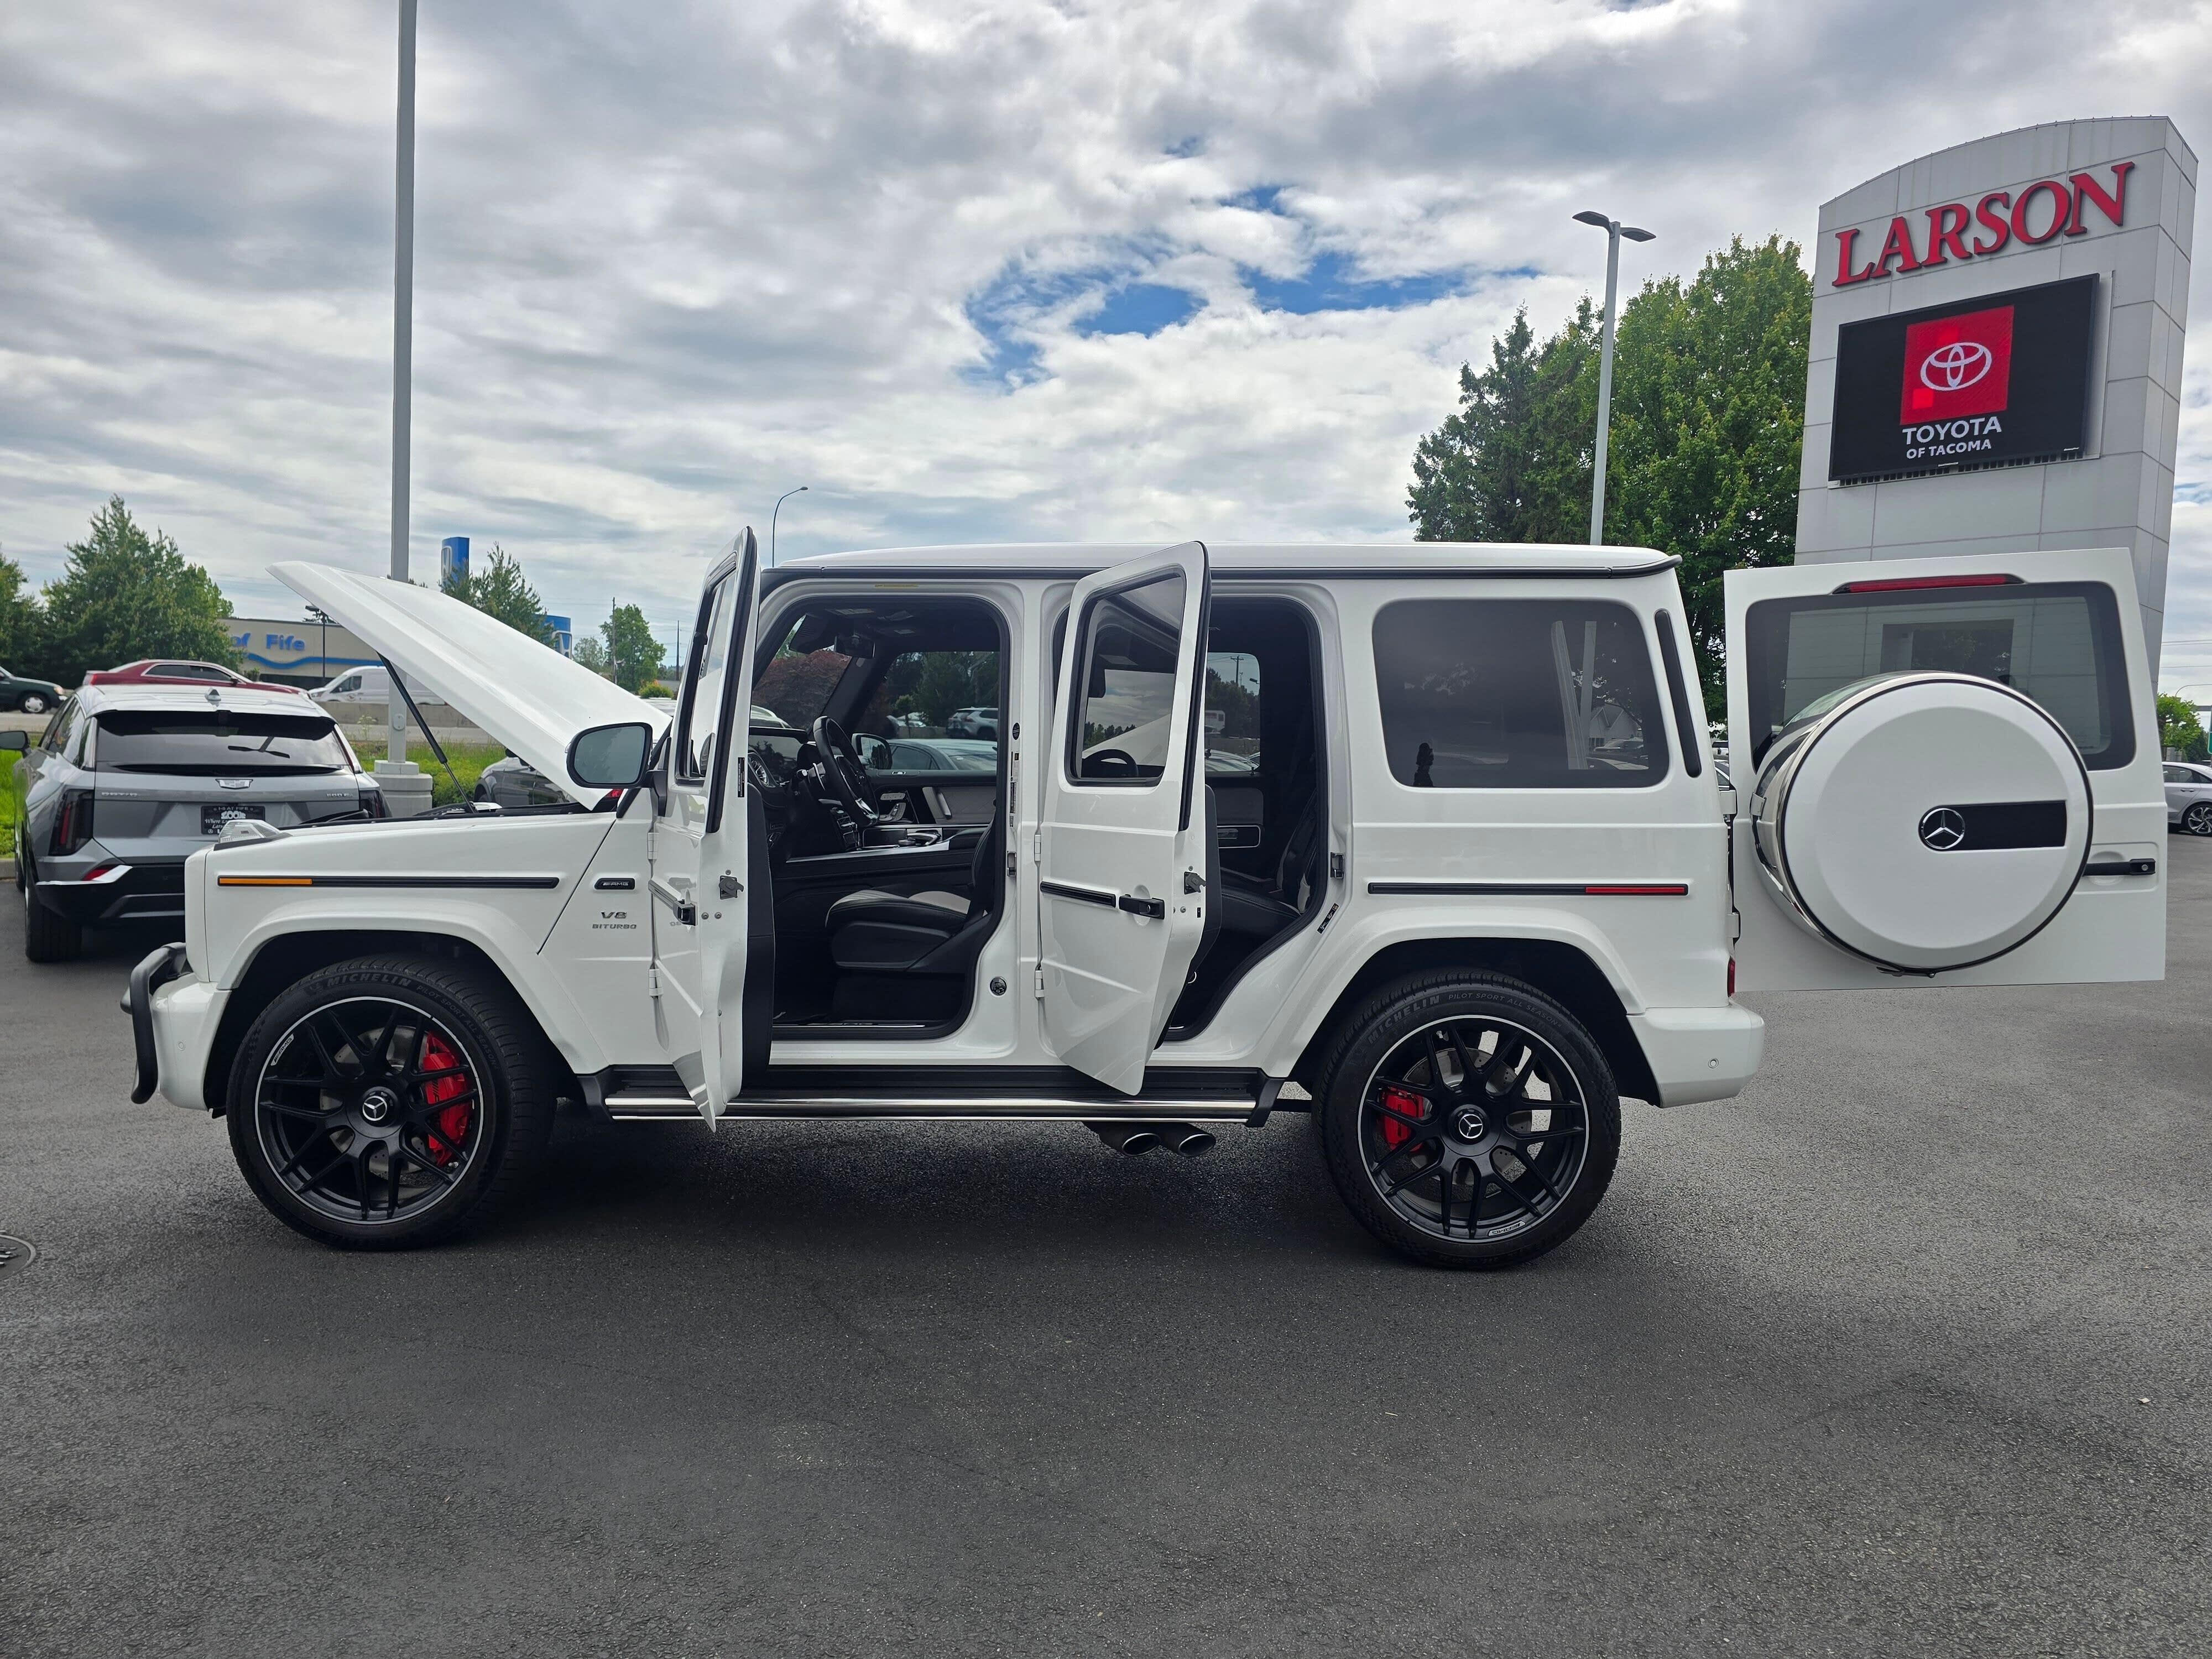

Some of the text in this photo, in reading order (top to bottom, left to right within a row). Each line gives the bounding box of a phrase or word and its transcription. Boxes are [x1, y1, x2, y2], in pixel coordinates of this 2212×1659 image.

[1832, 161, 2135, 286] LARSON
[1902, 416, 2002, 445] TOYOTA
[1906, 439, 1992, 459] OF TACOMA
[266, 634, 305, 651] Fife
[327, 973, 498, 1066] MICHELIN PILOT SPORT ALL SEASON
[1368, 995, 1439, 1044] MICHELIN
[1475, 993, 1505, 1001] SPORT
[1507, 998, 1522, 1007] ALL
[1526, 1005, 1558, 1026] SEASON
